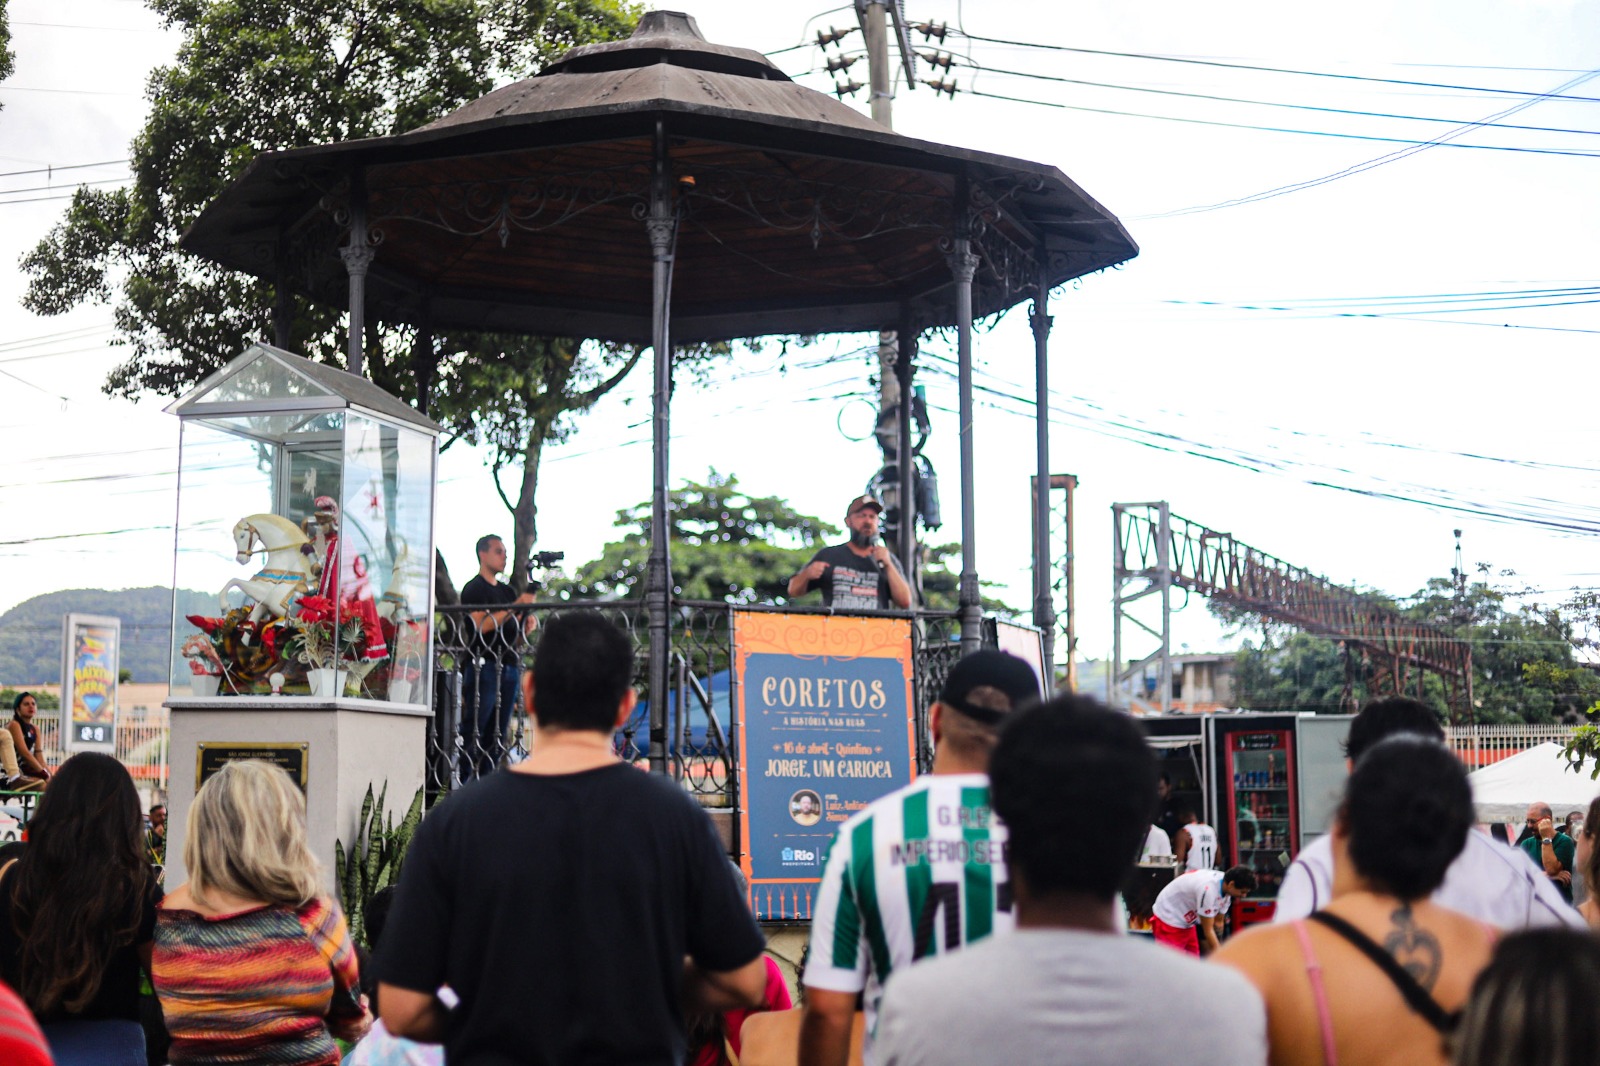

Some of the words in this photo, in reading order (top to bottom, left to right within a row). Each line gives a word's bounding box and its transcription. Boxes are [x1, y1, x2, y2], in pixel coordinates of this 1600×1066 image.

[762, 676, 886, 710] CORETOS
[783, 717, 789, 725] A
[790, 716, 826, 726] HISTÓRIA
[828, 718, 844, 727] NAS
[846, 718, 865, 727] RUAS
[783, 741, 795, 754] 16
[795, 742, 806, 754] de
[807, 742, 830, 755] abril
[835, 742, 873, 758] Quintino
[764, 759, 811, 778] JORGE,
[813, 760, 835, 777] UM
[837, 760, 892, 778] CARIOCA
[794, 849, 815, 861] Rio
